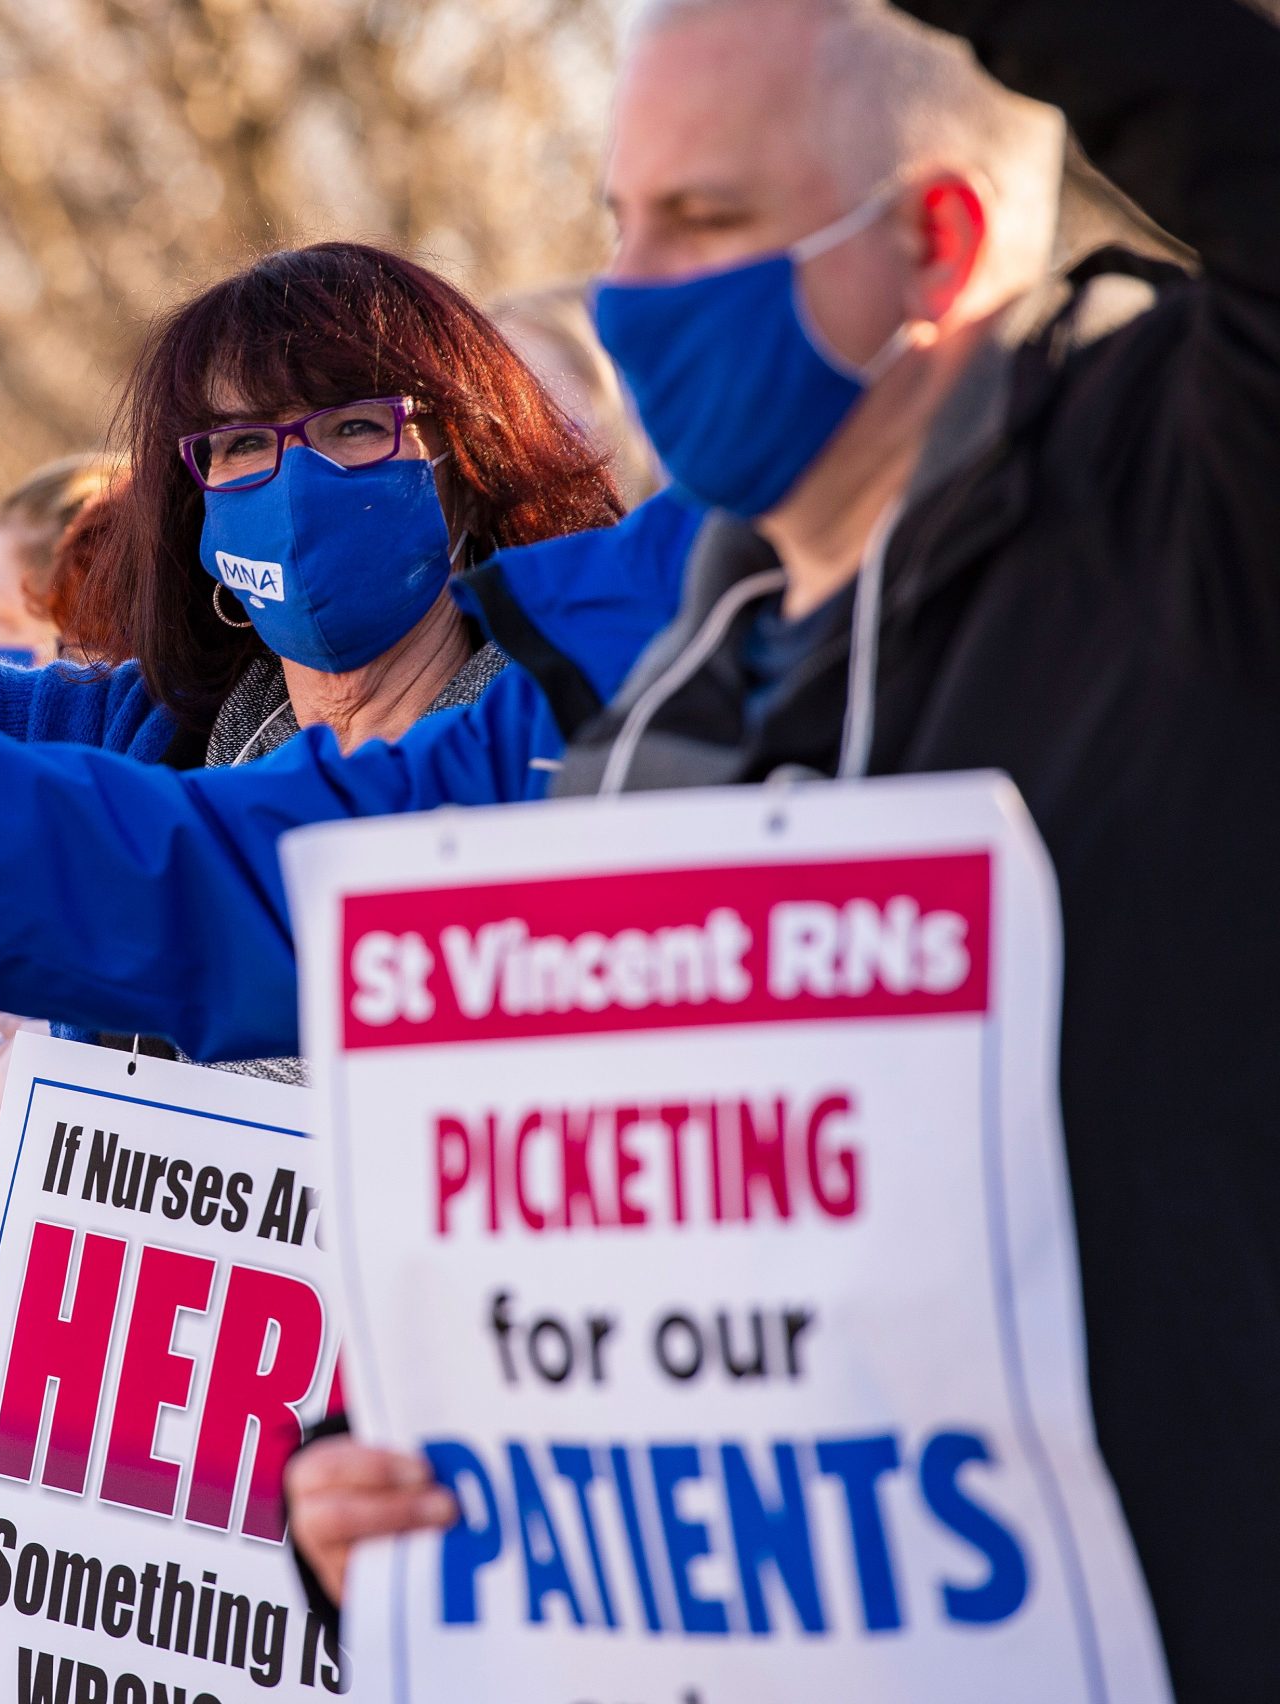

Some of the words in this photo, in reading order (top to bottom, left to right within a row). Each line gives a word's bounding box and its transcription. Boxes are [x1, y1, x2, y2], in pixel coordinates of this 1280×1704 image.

[222, 558, 278, 594] MNA
[350, 930, 434, 1026] St
[440, 907, 752, 1020] Vincent
[766, 895, 972, 1001] RNs
[42, 1121, 83, 1196] If
[82, 1129, 253, 1232] Nurses
[257, 1167, 327, 1253] Ar
[433, 1089, 864, 1238] PICKETING
[489, 1288, 614, 1384] for
[655, 1308, 813, 1382] our
[422, 1424, 1034, 1638] PATIENTS
